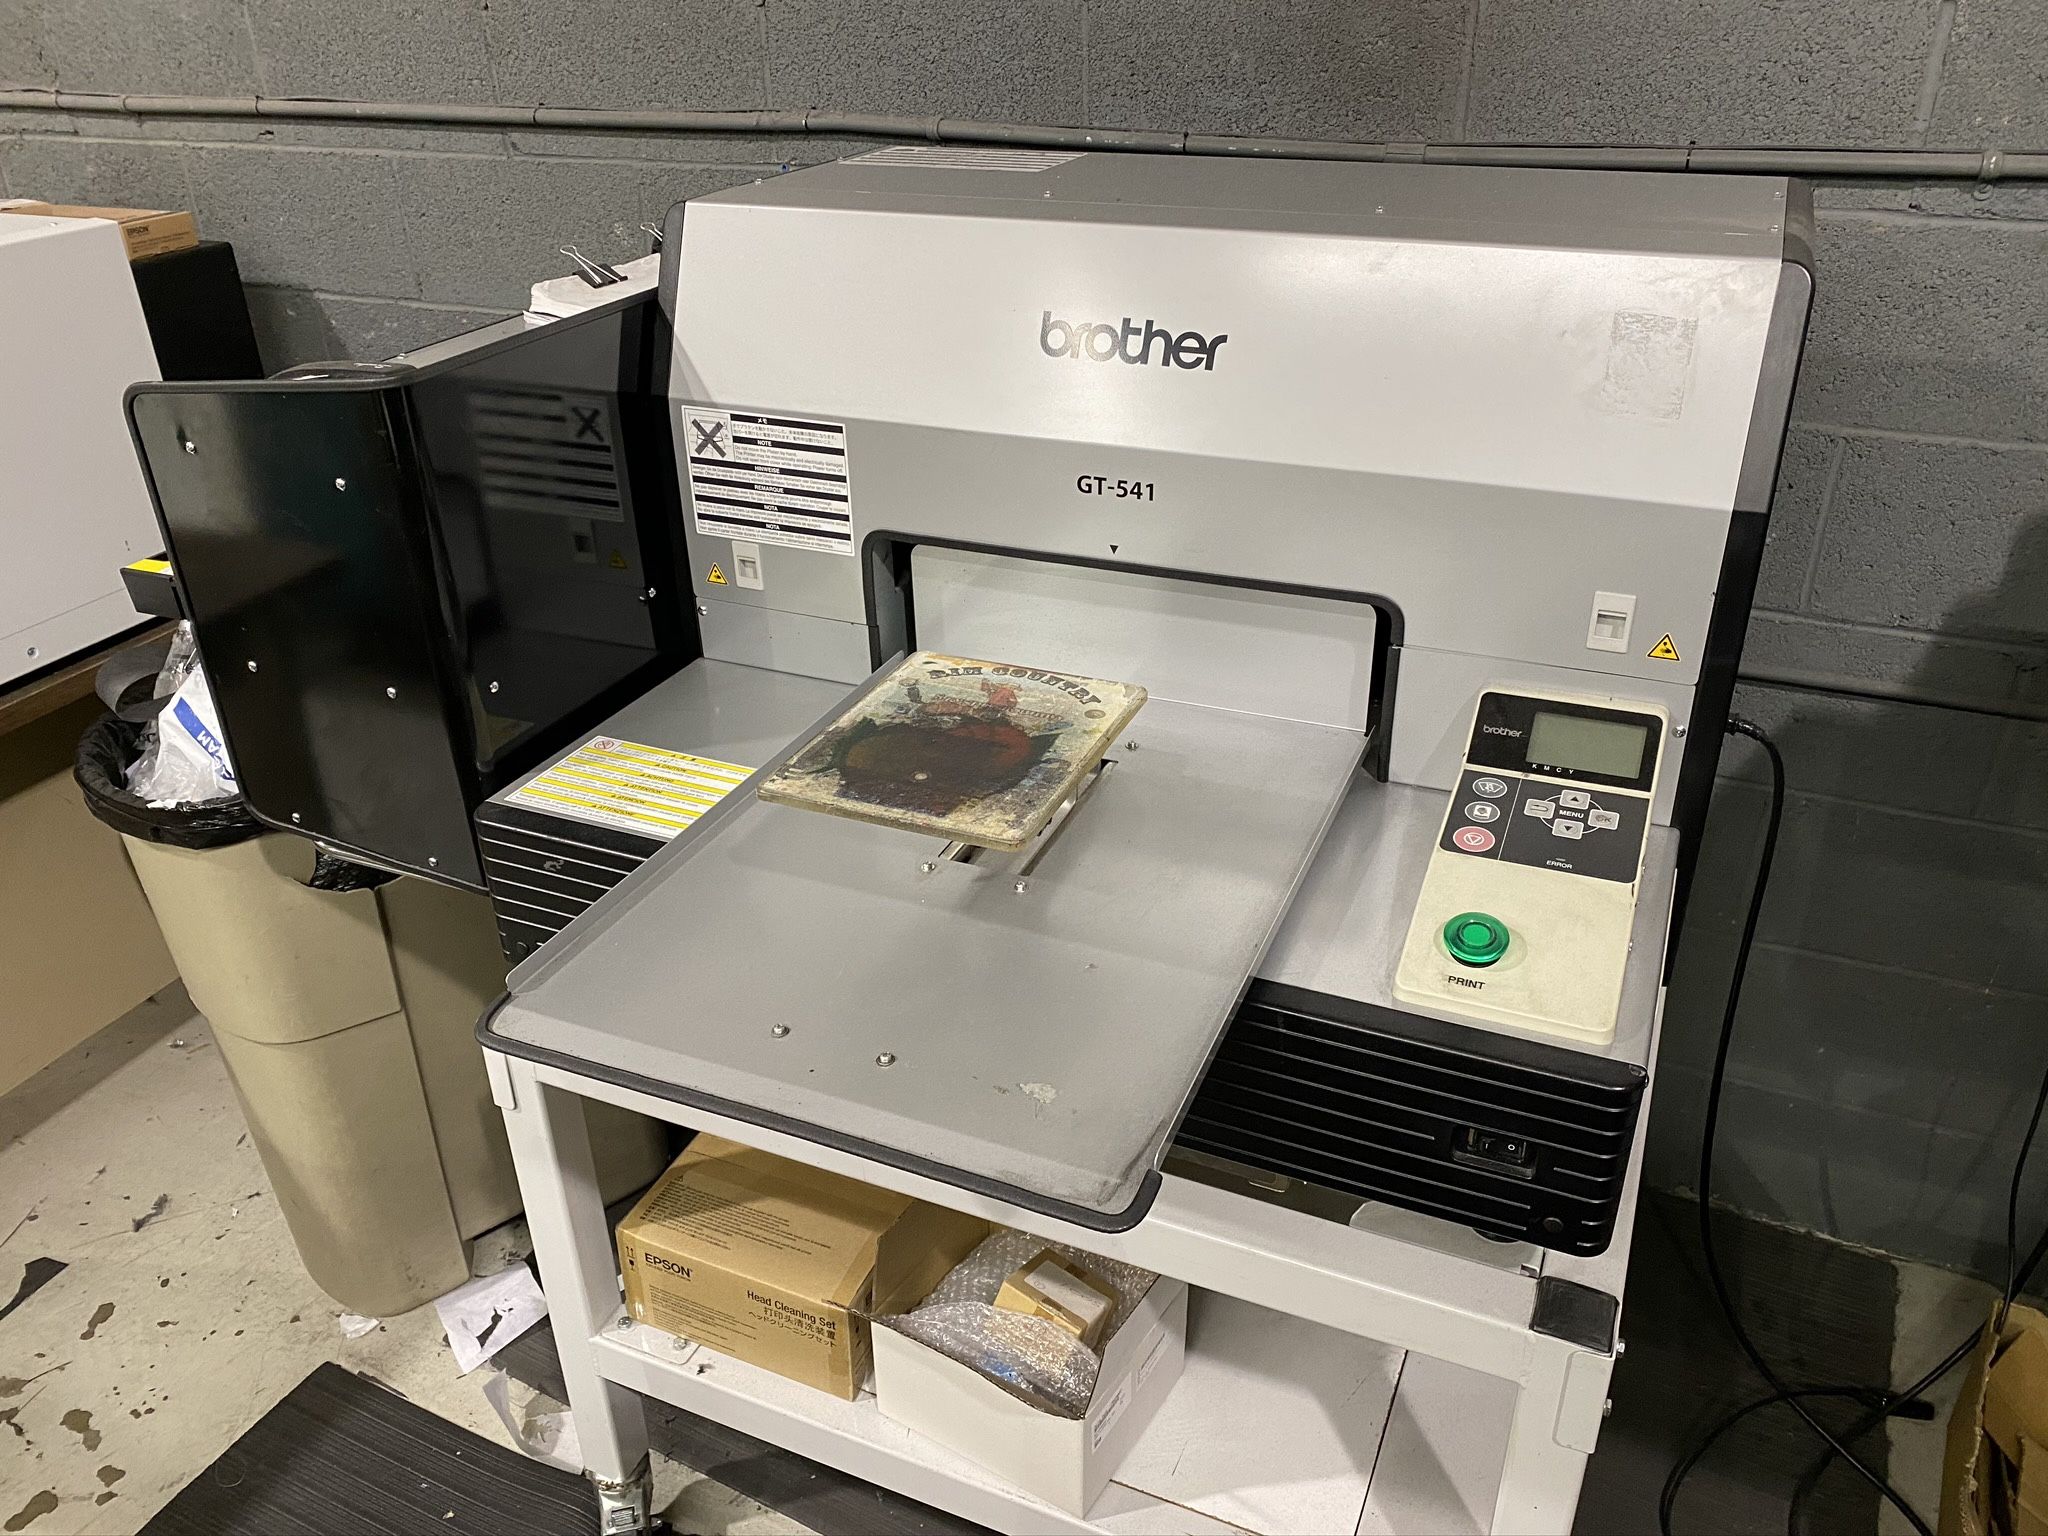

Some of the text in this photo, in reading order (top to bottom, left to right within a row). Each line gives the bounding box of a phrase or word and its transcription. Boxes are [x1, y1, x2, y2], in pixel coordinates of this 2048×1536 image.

[1040, 310, 1229, 371] brother
[757, 439, 772, 447] NOTE
[754, 484, 785, 494] REMARQUE
[1077, 475, 1155, 501] GT-541
[763, 504, 779, 512] NOTA
[765, 523, 780, 531] NOTA
[991, 667, 1101, 704] COUNTRY
[1483, 724, 1522, 737] brother
[1559, 809, 1584, 819] MENU
[1546, 859, 1573, 870] ERROR
[1448, 975, 1486, 990] PRINT
[645, 1252, 691, 1278] EPSON
[747, 1290, 836, 1330] Head Cleaning Set
